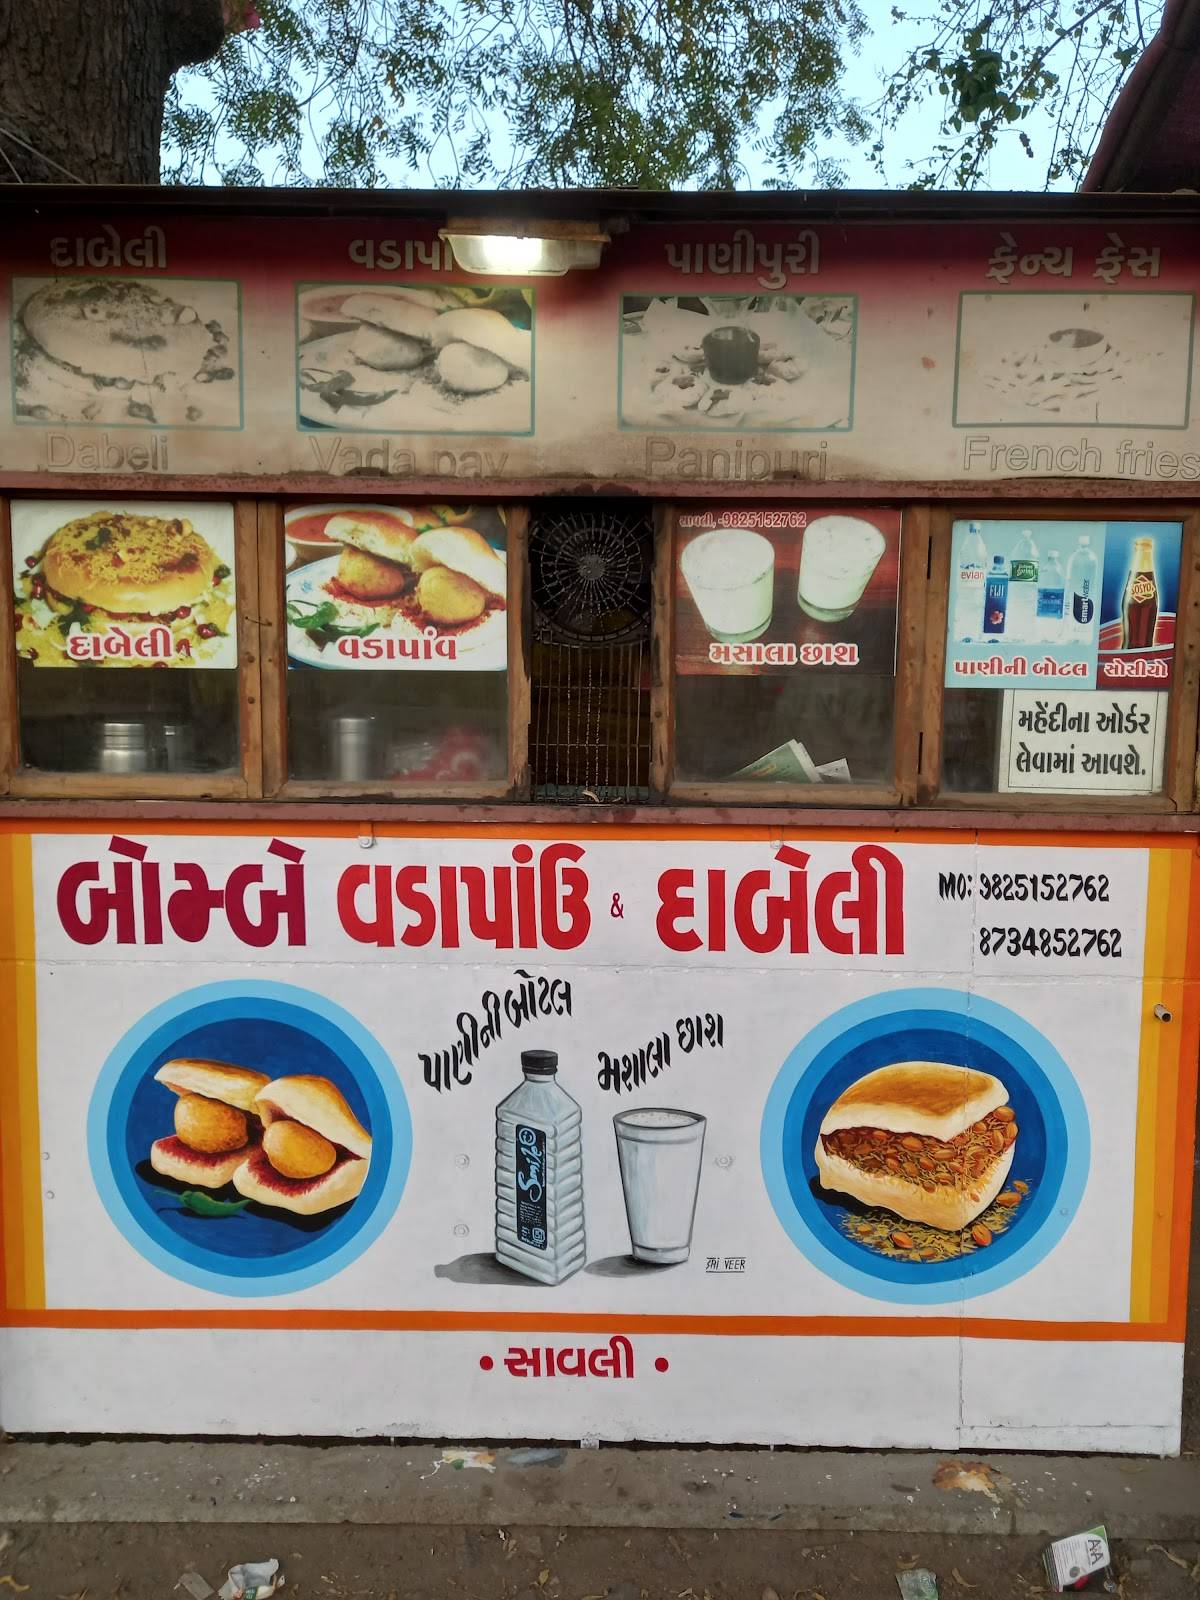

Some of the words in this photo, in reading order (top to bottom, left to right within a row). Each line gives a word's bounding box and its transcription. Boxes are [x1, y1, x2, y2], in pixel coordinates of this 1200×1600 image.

[50, 224, 167, 269] દાબેલી
[665, 229, 820, 290] પાણીપુરી
[46, 432, 169, 472] Dabeli
[308, 435, 417, 477] Vada
[645, 436, 828, 481] Panipuri
[963, 435, 1102, 473] French
[1116, 440, 1200, 480] fries
[989, 584, 1005, 599] FIJI
[69, 625, 173, 659] દાબેલી
[338, 628, 458, 660] વડાપાંવ
[709, 643, 798, 665] મસાલા
[800, 643, 859, 665] છાશ
[954, 656, 1028, 677] પાણીની
[1031, 656, 1089, 677] બોટલ
[1104, 658, 1168, 677] સોસીયો
[1018, 701, 1089, 733] મહેંદીના
[1096, 703, 1151, 734] ઓર્ડર
[1016, 742, 1075, 773] લેવામાં
[1081, 744, 1146, 775] આવશે.
[56, 835, 307, 947] બોમ્બે
[337, 843, 592, 950] વડાપાંઉ
[610, 892, 624, 919] &
[656, 844, 905, 955] દાબેલી
[979, 873, 1110, 902] 9825152762
[979, 926, 1122, 957] 8734852762
[597, 1031, 671, 1096] મશાલા
[676, 1013, 723, 1053] છાશ
[518, 1145, 542, 1202] Smile
[724, 1259, 746, 1270] VEER
[504, 1335, 635, 1378] સાવલી
